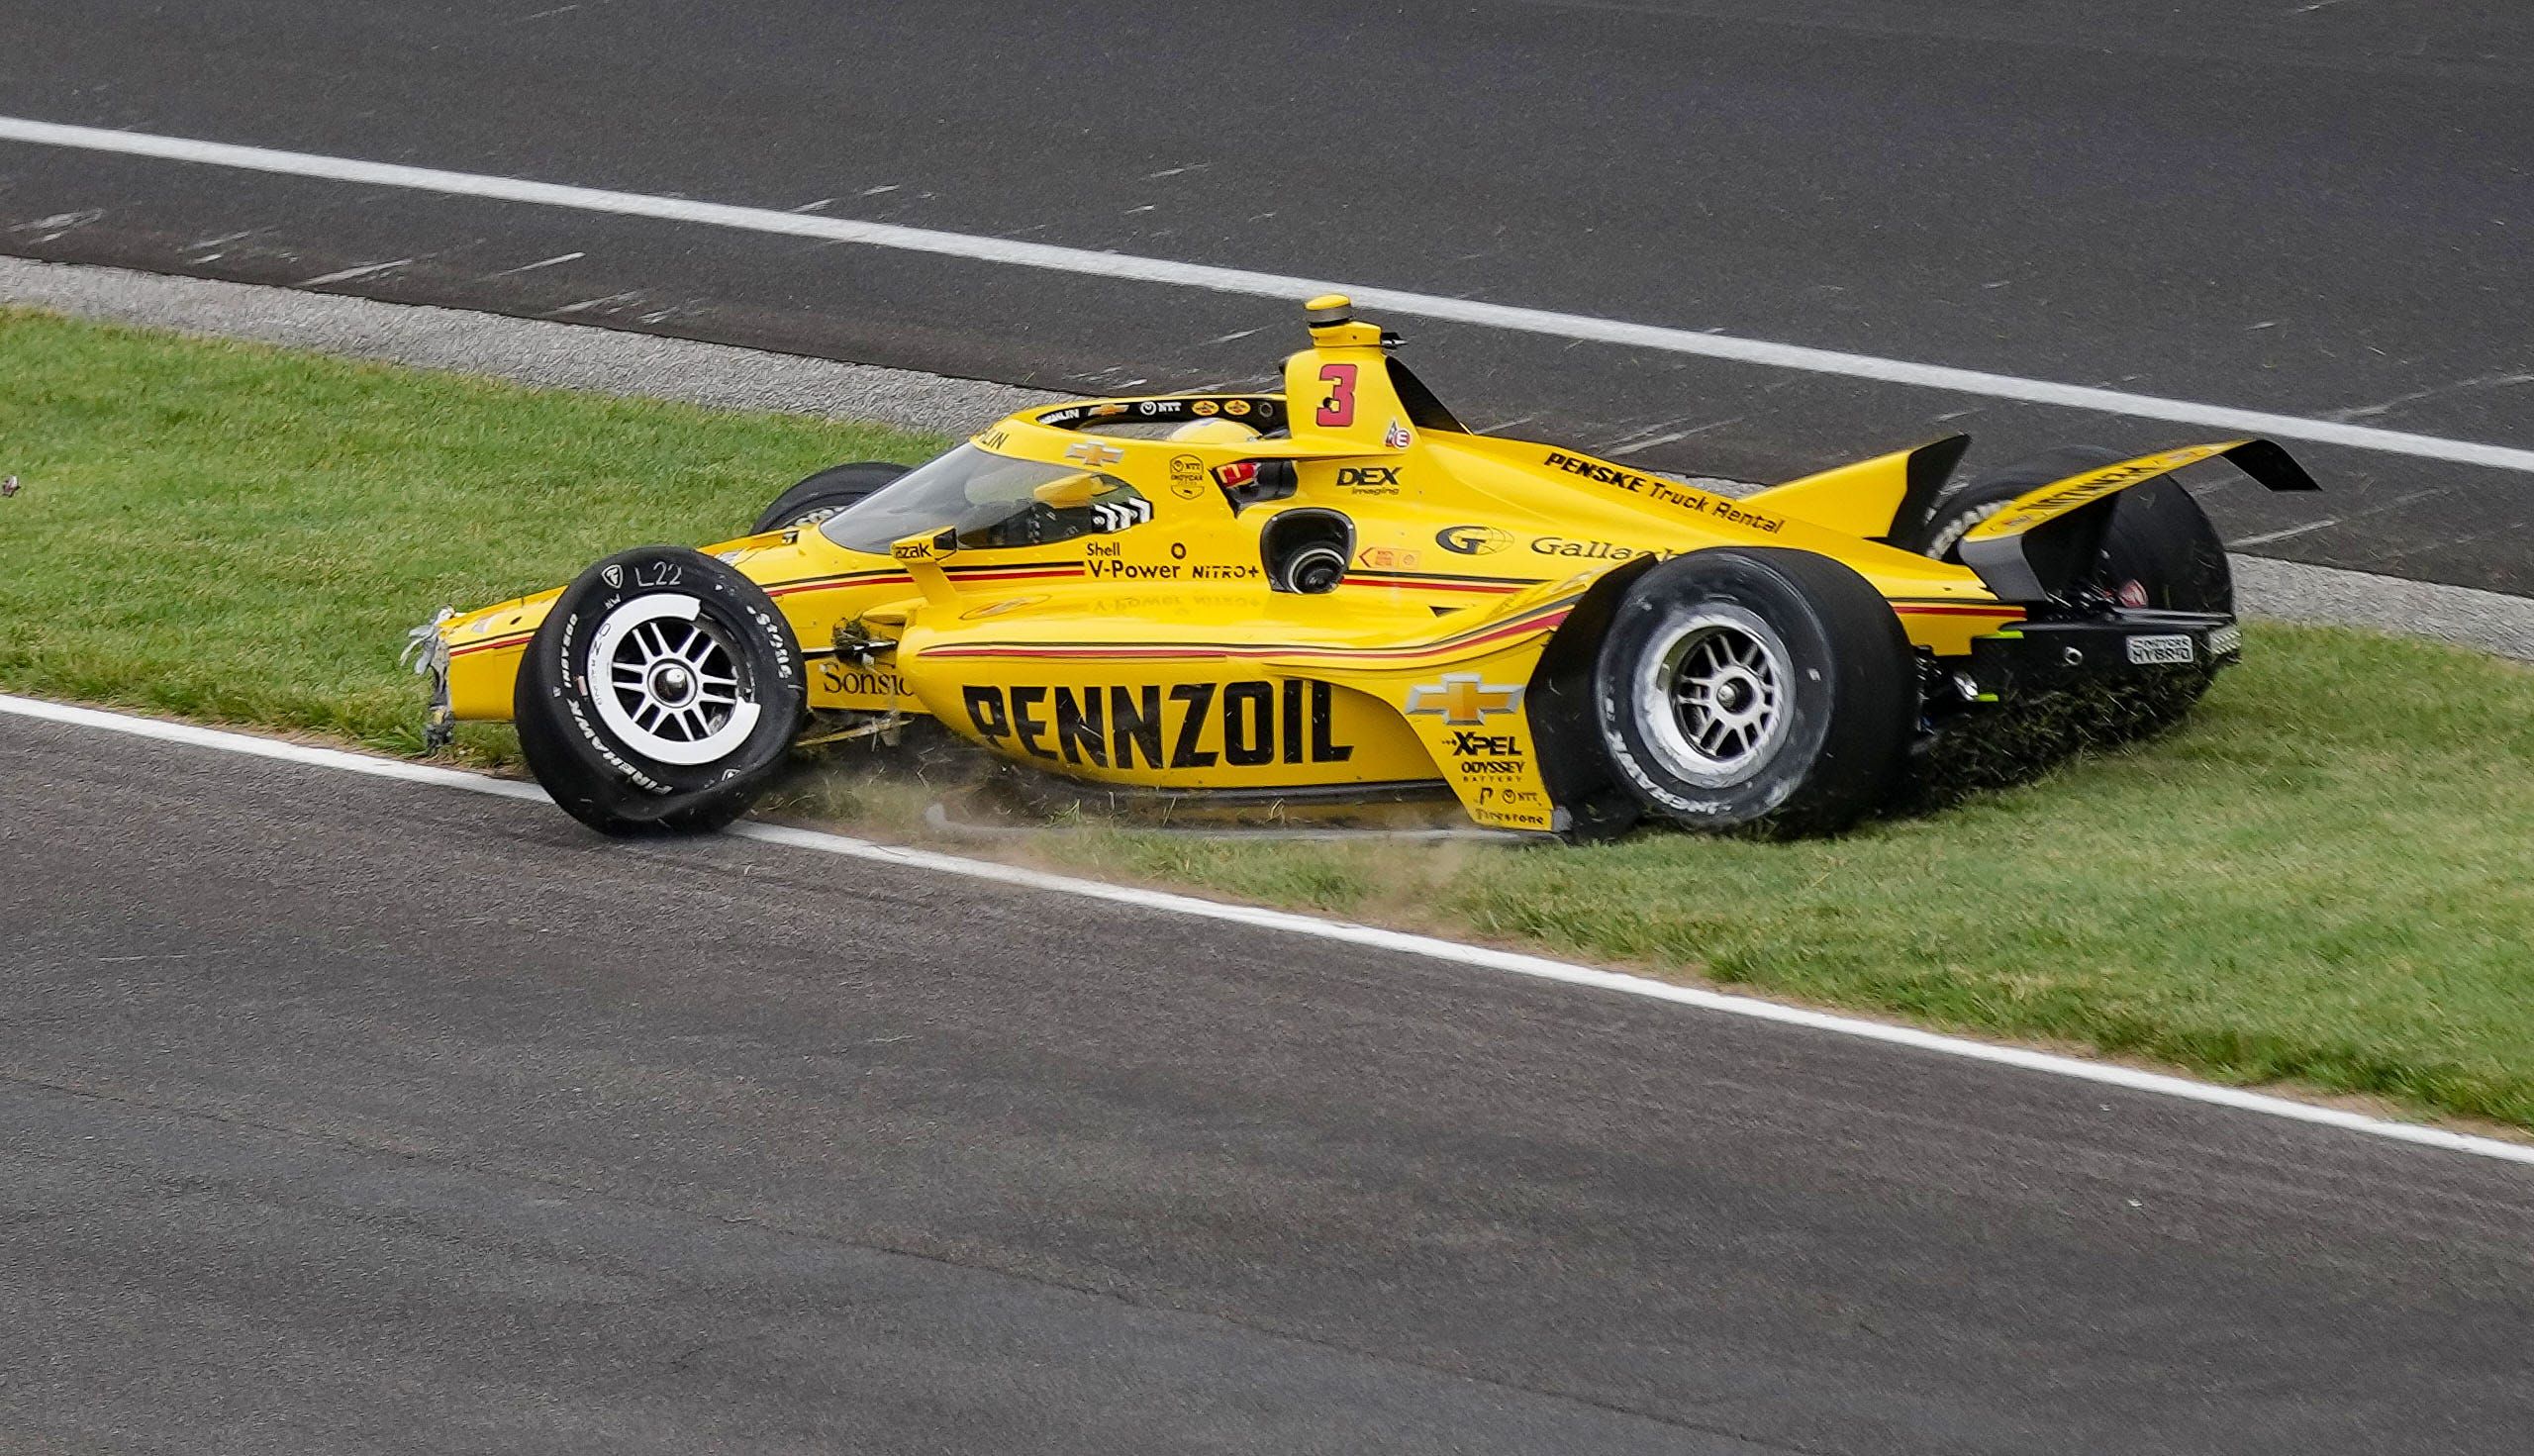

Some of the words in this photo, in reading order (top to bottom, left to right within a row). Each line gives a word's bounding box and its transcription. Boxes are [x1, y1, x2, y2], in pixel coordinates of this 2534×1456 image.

[1316, 363, 1358, 428] 3
[1336, 466, 1404, 487] DEX
[1543, 452, 1647, 493] PENSKE
[1649, 482, 1710, 513] Truck
[1711, 501, 1787, 534] Rental
[1087, 542, 1121, 557] Shell
[1531, 536, 1673, 561] Galla
[634, 560, 683, 588] L22
[1088, 559, 1181, 579] V-Power
[962, 678, 1356, 770] PENNZOIL
[1452, 730, 1523, 757] XPEL
[1461, 761, 1525, 774] ODYSSEY
